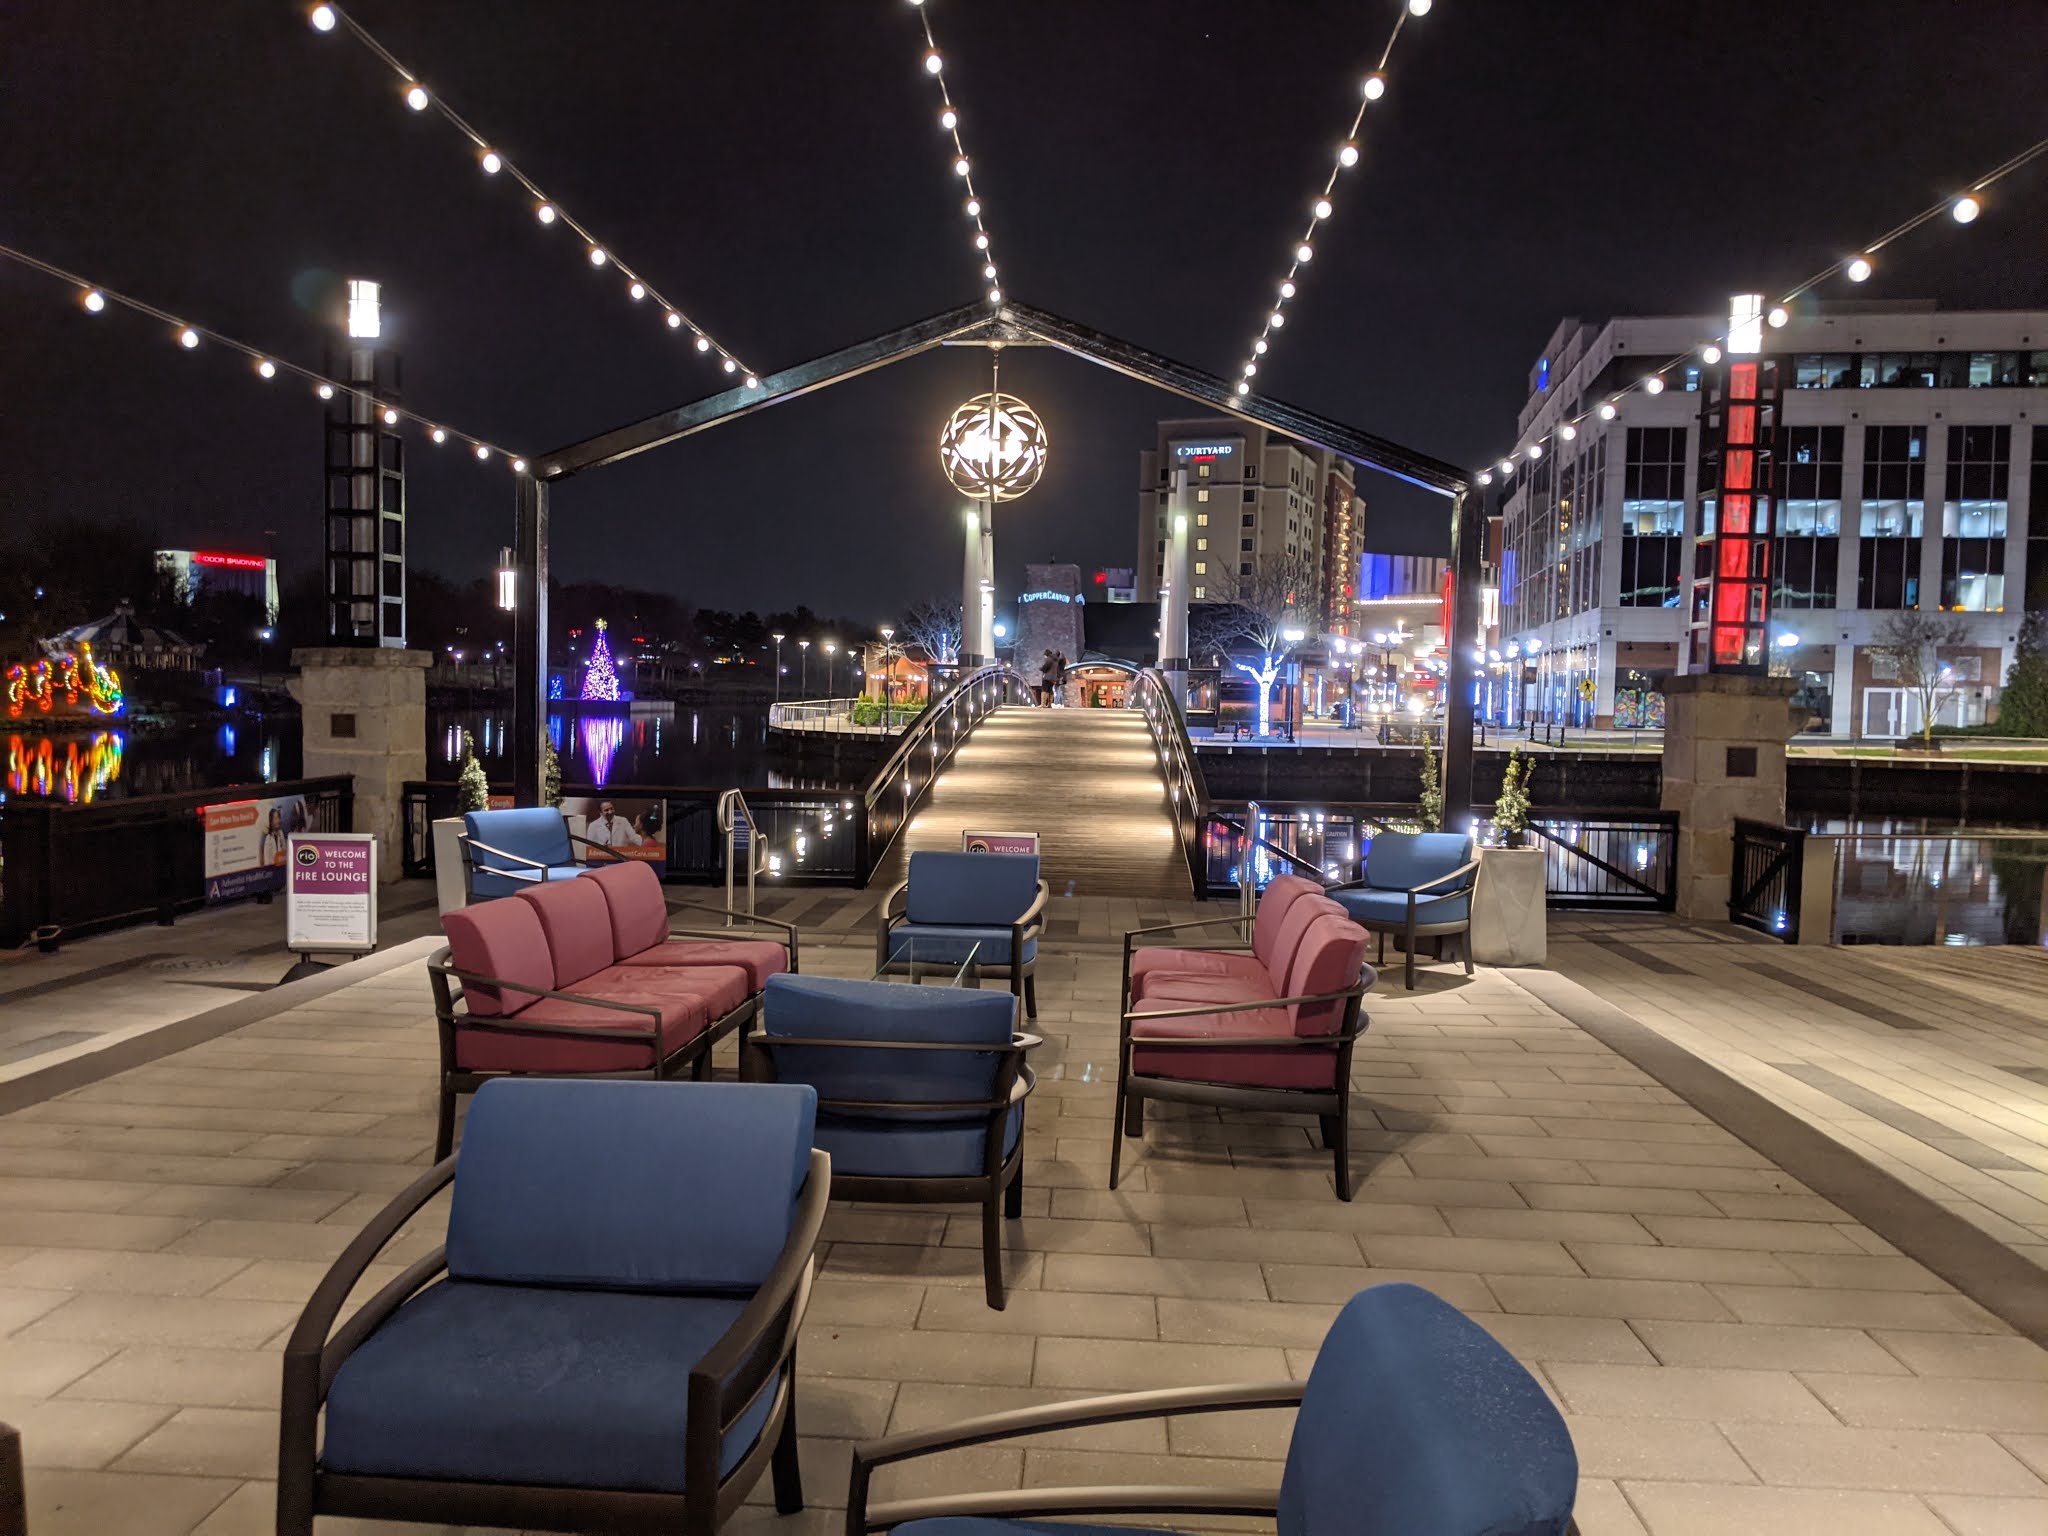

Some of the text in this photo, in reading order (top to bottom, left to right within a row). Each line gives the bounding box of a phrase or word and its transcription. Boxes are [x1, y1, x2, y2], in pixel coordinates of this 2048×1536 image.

[1177, 446, 1232, 456] COURTYARD
[994, 845, 1030, 854] WELCOME
[299, 852, 315, 860] rio
[324, 850, 367, 859] WELCOME
[324, 861, 354, 869] TO THE
[295, 871, 368, 882] FIRE LOUNGE
